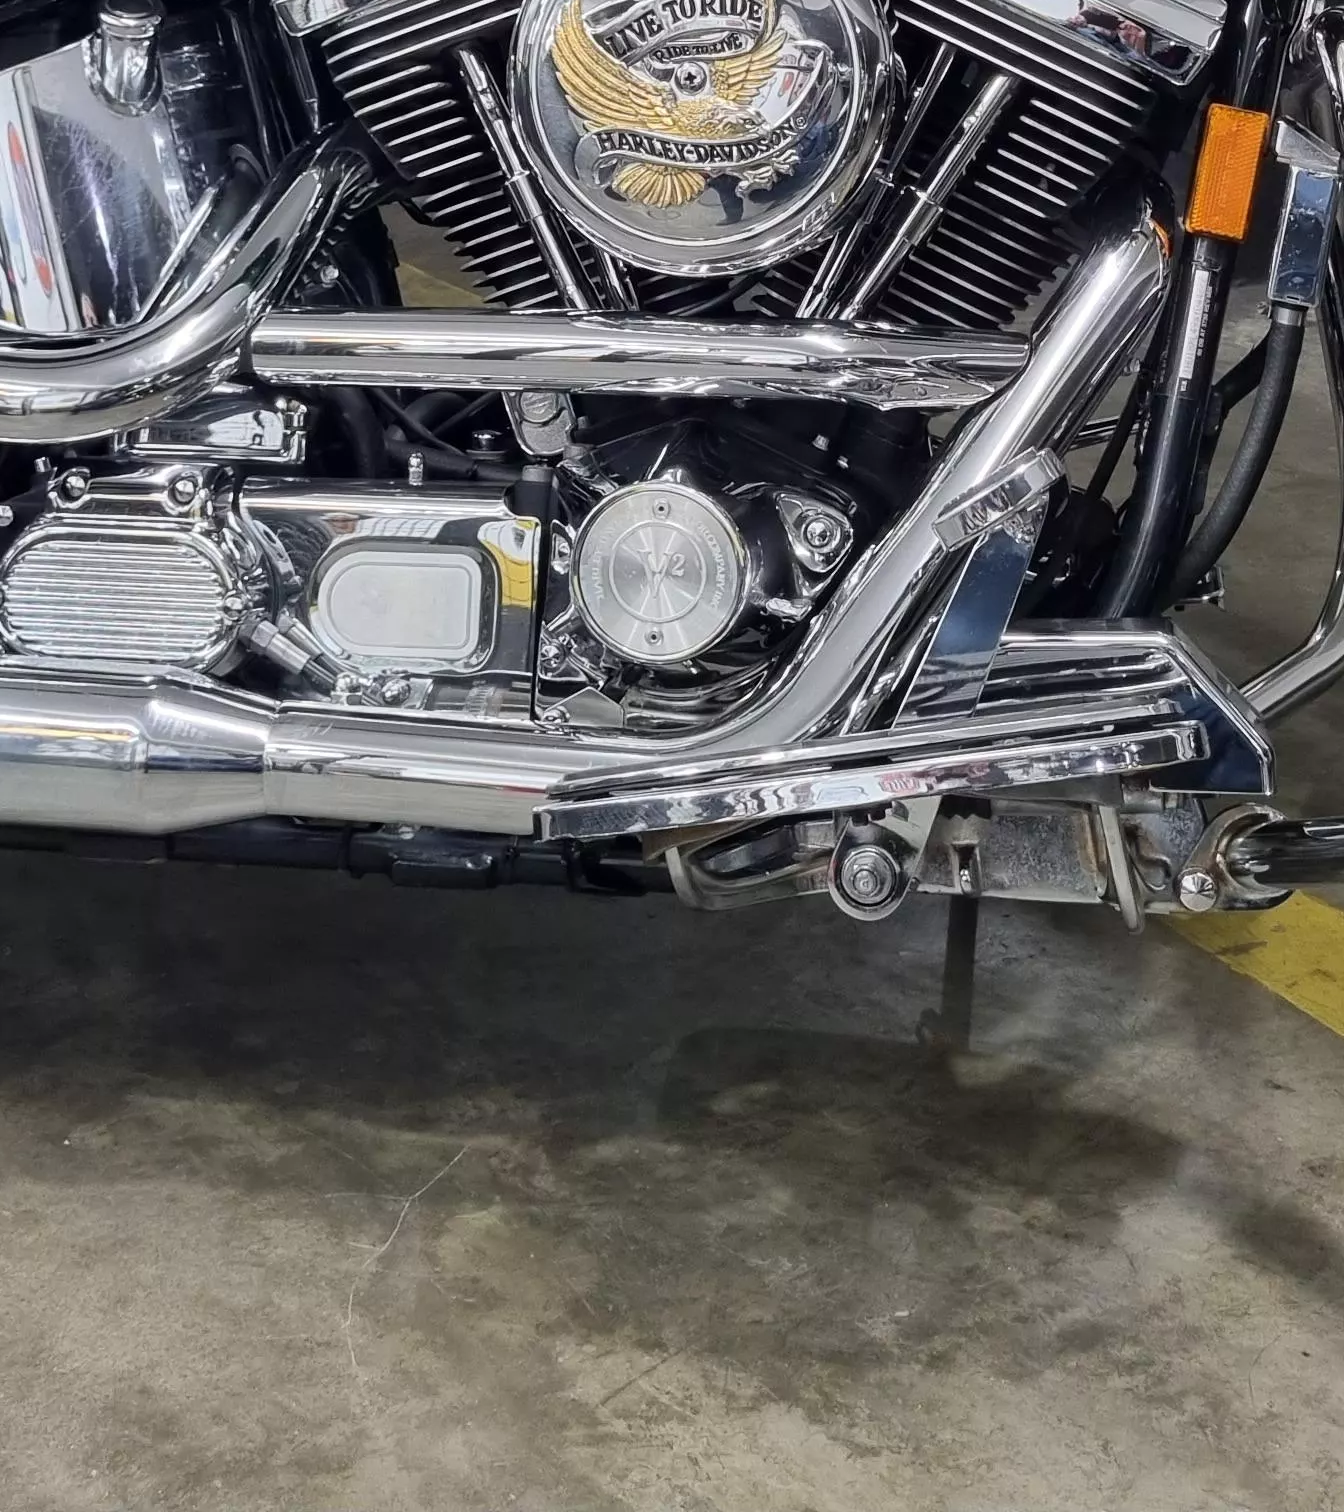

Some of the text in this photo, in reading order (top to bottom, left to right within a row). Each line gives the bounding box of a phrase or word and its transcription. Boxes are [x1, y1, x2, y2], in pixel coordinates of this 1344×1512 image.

[604, 17, 662, 59] LIVE
[654, 43, 691, 61] RIDE
[596, 119, 796, 165] HARLEY-DAVIDSON
